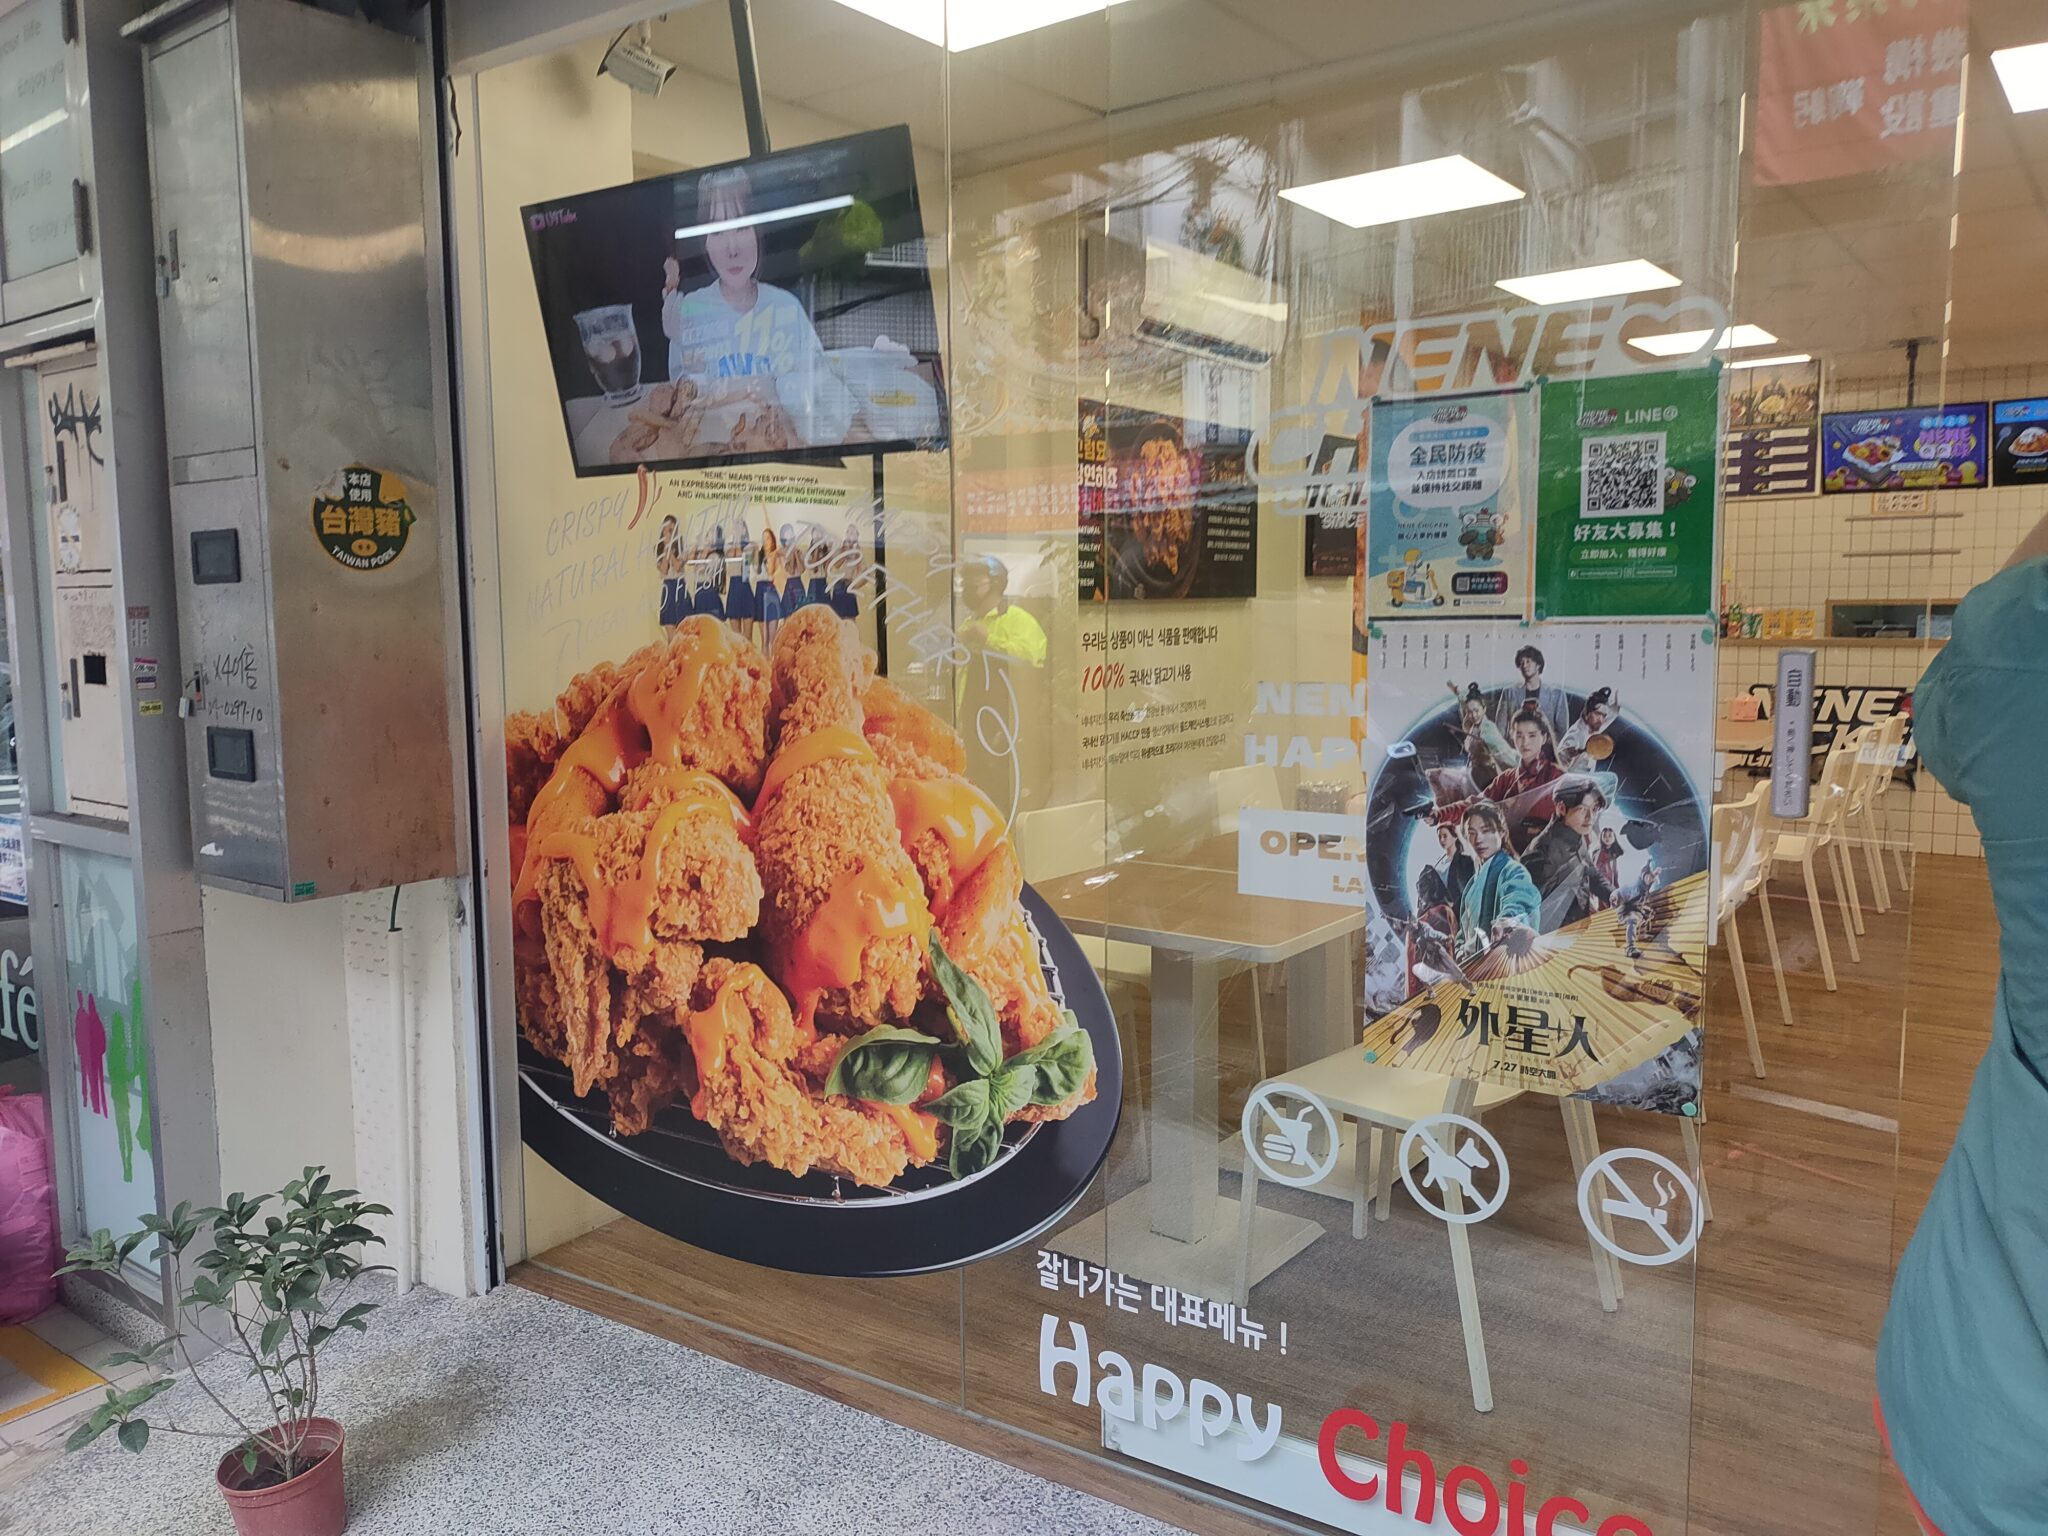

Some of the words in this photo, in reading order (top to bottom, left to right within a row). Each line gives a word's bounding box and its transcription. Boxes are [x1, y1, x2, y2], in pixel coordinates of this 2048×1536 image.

[1624, 405, 1679, 425] LINE@
[1409, 441, 1487, 467] 全民防疫
[348, 472, 372, 487] 本店
[728, 472, 753, 481] MEANS
[348, 488, 372, 502] 使用
[669, 479, 680, 487] AN
[681, 480, 727, 490] EXPRESSION
[768, 485, 806, 496] INDICATING
[806, 487, 847, 498] ENTHUSIASM
[677, 490, 693, 499] AND
[794, 496, 809, 505] AND
[321, 504, 401, 537] 台灣豬
[546, 487, 631, 557] CRISPY
[331, 545, 369, 568] TAIWAN
[370, 546, 397, 568] PORK
[1081, 632, 1108, 653] 우리는
[1110, 629, 1136, 651] 상품이
[1137, 628, 1154, 648] 아닌
[1157, 626, 1181, 647] 식품을
[1182, 624, 1219, 646] 판매합니다
[1081, 662, 1125, 694] 100%
[1129, 666, 1153, 688] 국내산
[1154, 664, 1176, 686] 닭고기
[1177, 663, 1192, 683] 사용
[1493, 1060, 1518, 1073] 7.27
[1036, 1250, 1142, 1315] 잘나가는
[1150, 1283, 1268, 1352] 대표메뉴
[1038, 1312, 1283, 1463] Happy
